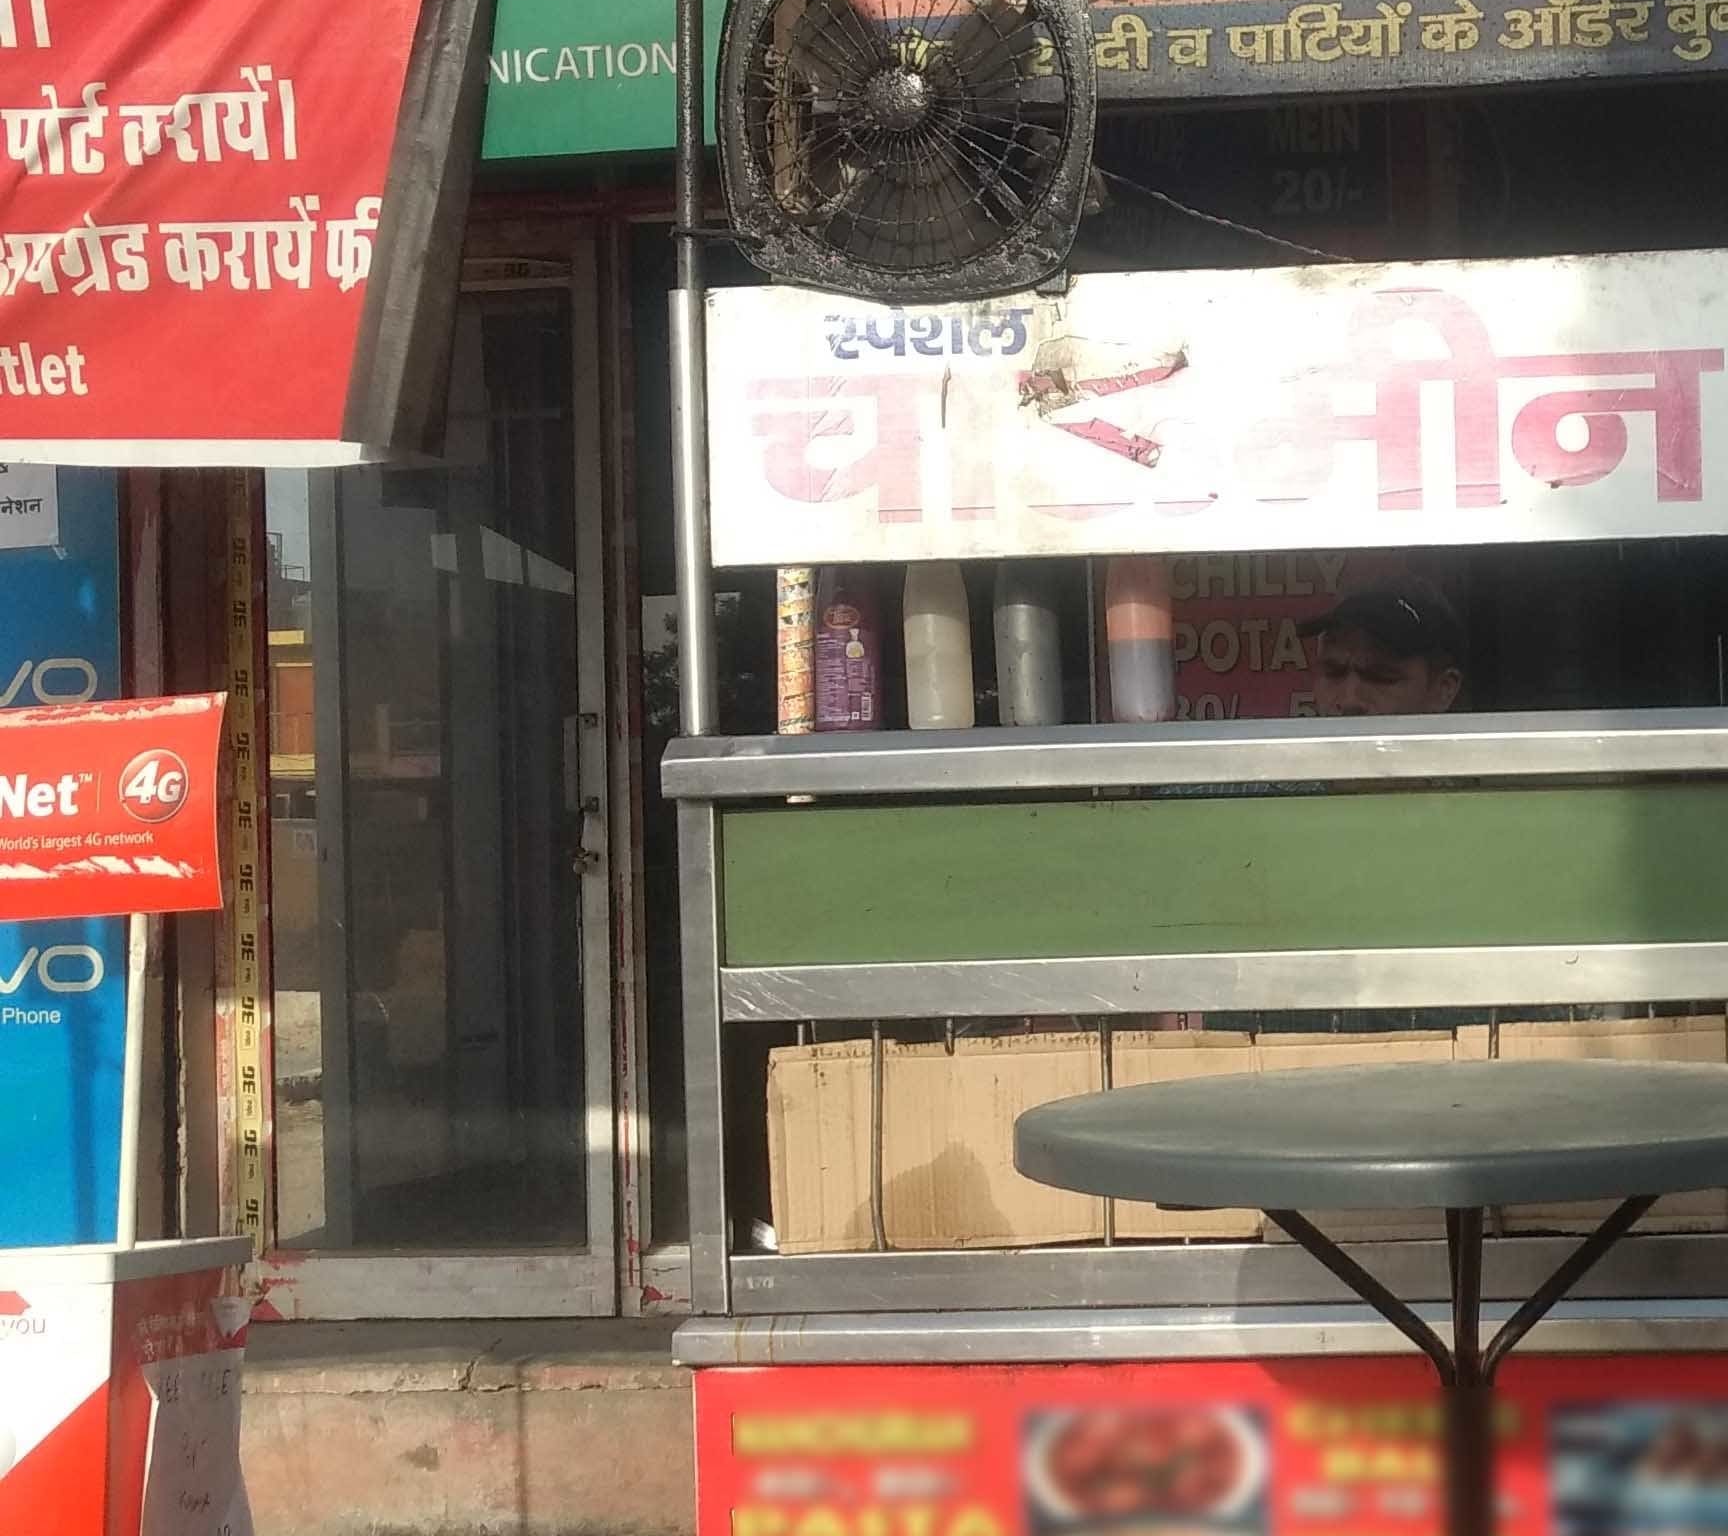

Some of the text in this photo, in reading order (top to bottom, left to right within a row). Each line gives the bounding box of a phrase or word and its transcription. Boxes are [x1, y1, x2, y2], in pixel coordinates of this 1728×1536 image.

[1417, 0, 1486, 57] के
[488, 42, 677, 87] NICATION
[159, 194, 321, 291] करायें
[1176, 618, 1310, 673] POTA
[124, 760, 183, 806] 4G
[41, 834, 82, 852] largest
[84, 832, 102, 847] 4G
[104, 831, 153, 846] network
[2, 1007, 62, 1026] Phone
